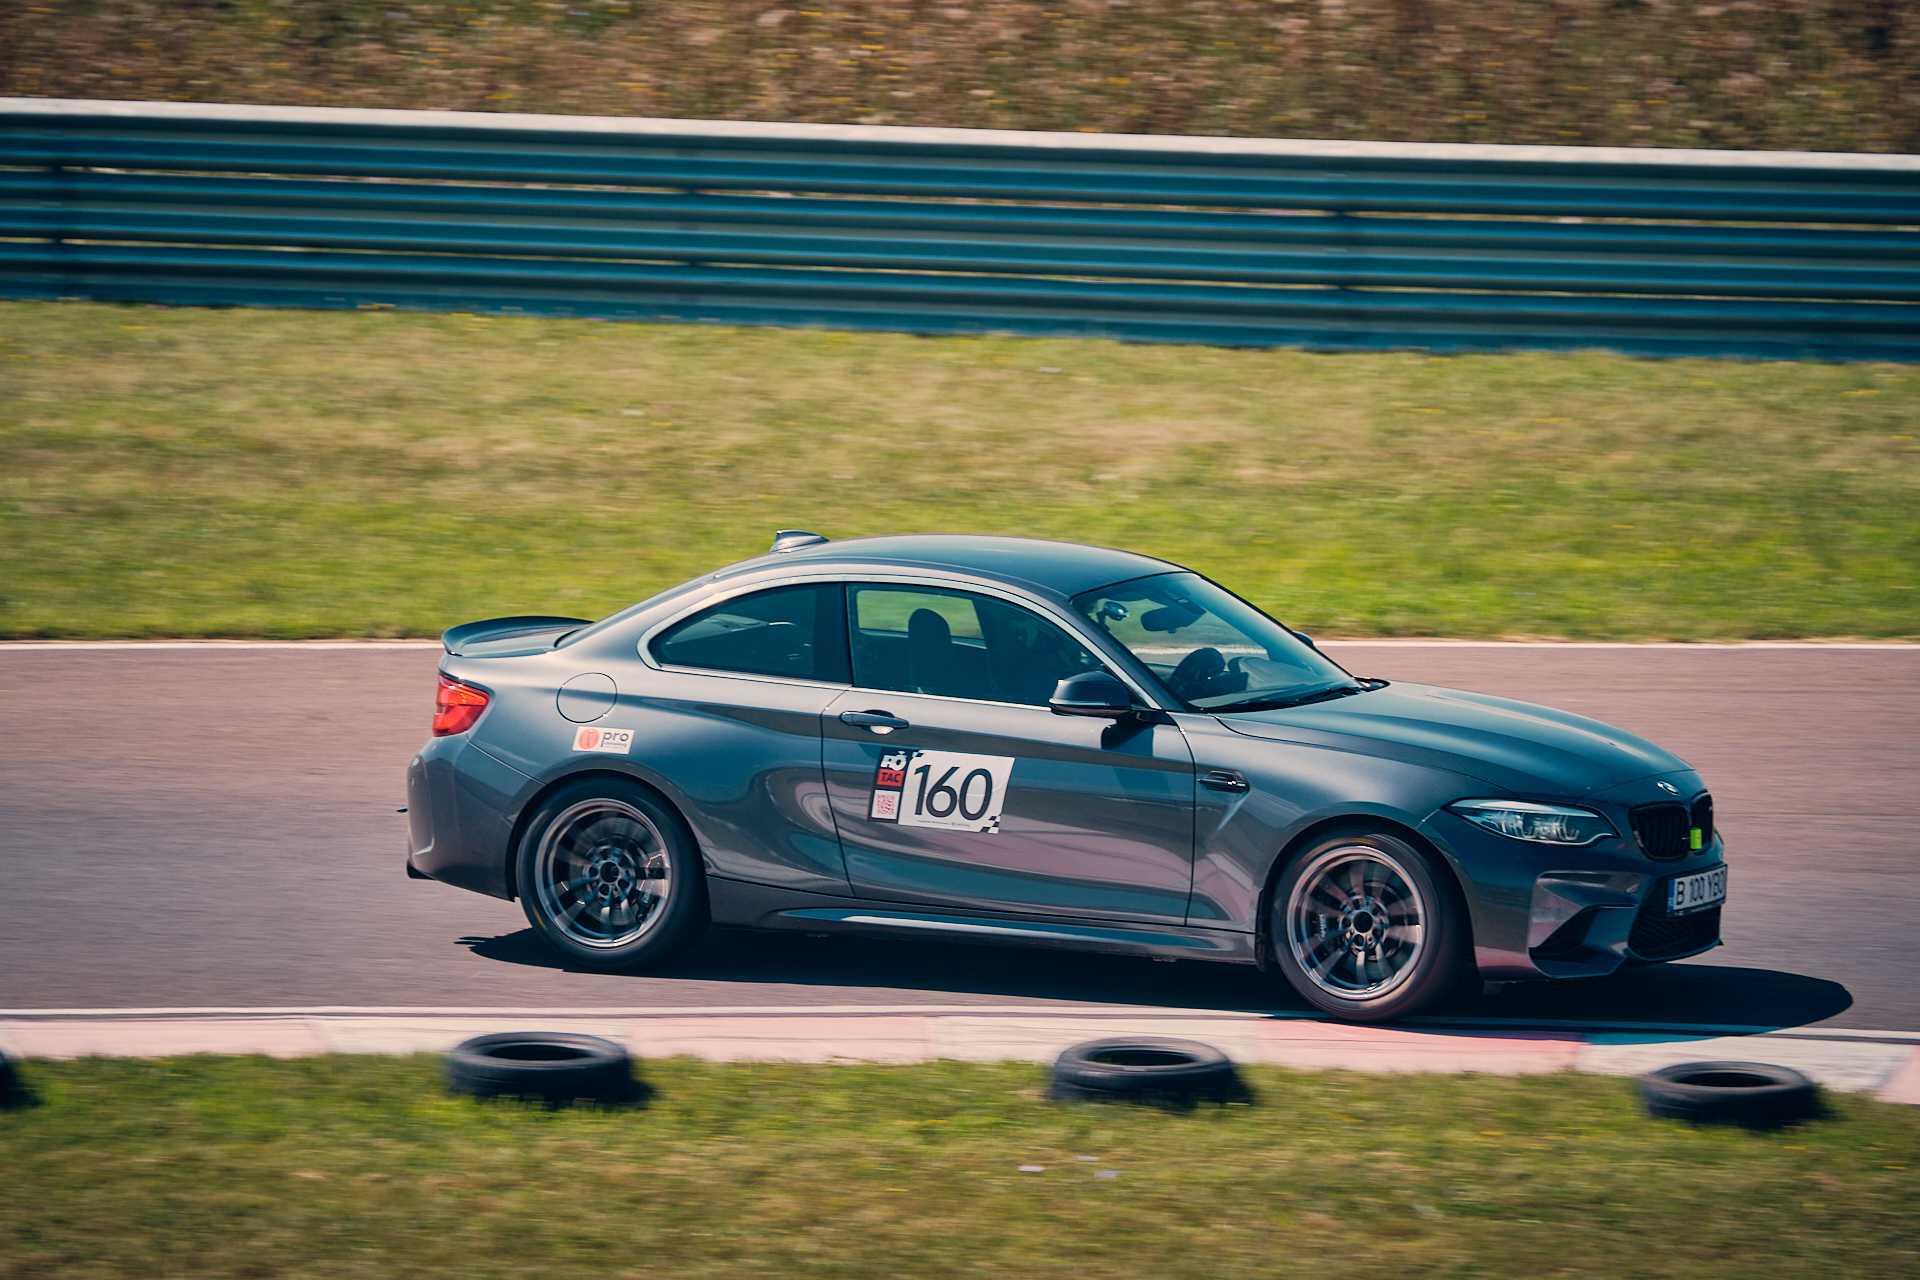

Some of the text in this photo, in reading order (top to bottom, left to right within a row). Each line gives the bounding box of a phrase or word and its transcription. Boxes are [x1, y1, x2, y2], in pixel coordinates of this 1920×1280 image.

[600, 731, 629, 748] pro
[881, 772, 902, 783] TAC
[914, 764, 993, 821] 160
[1676, 881, 1685, 906] B
